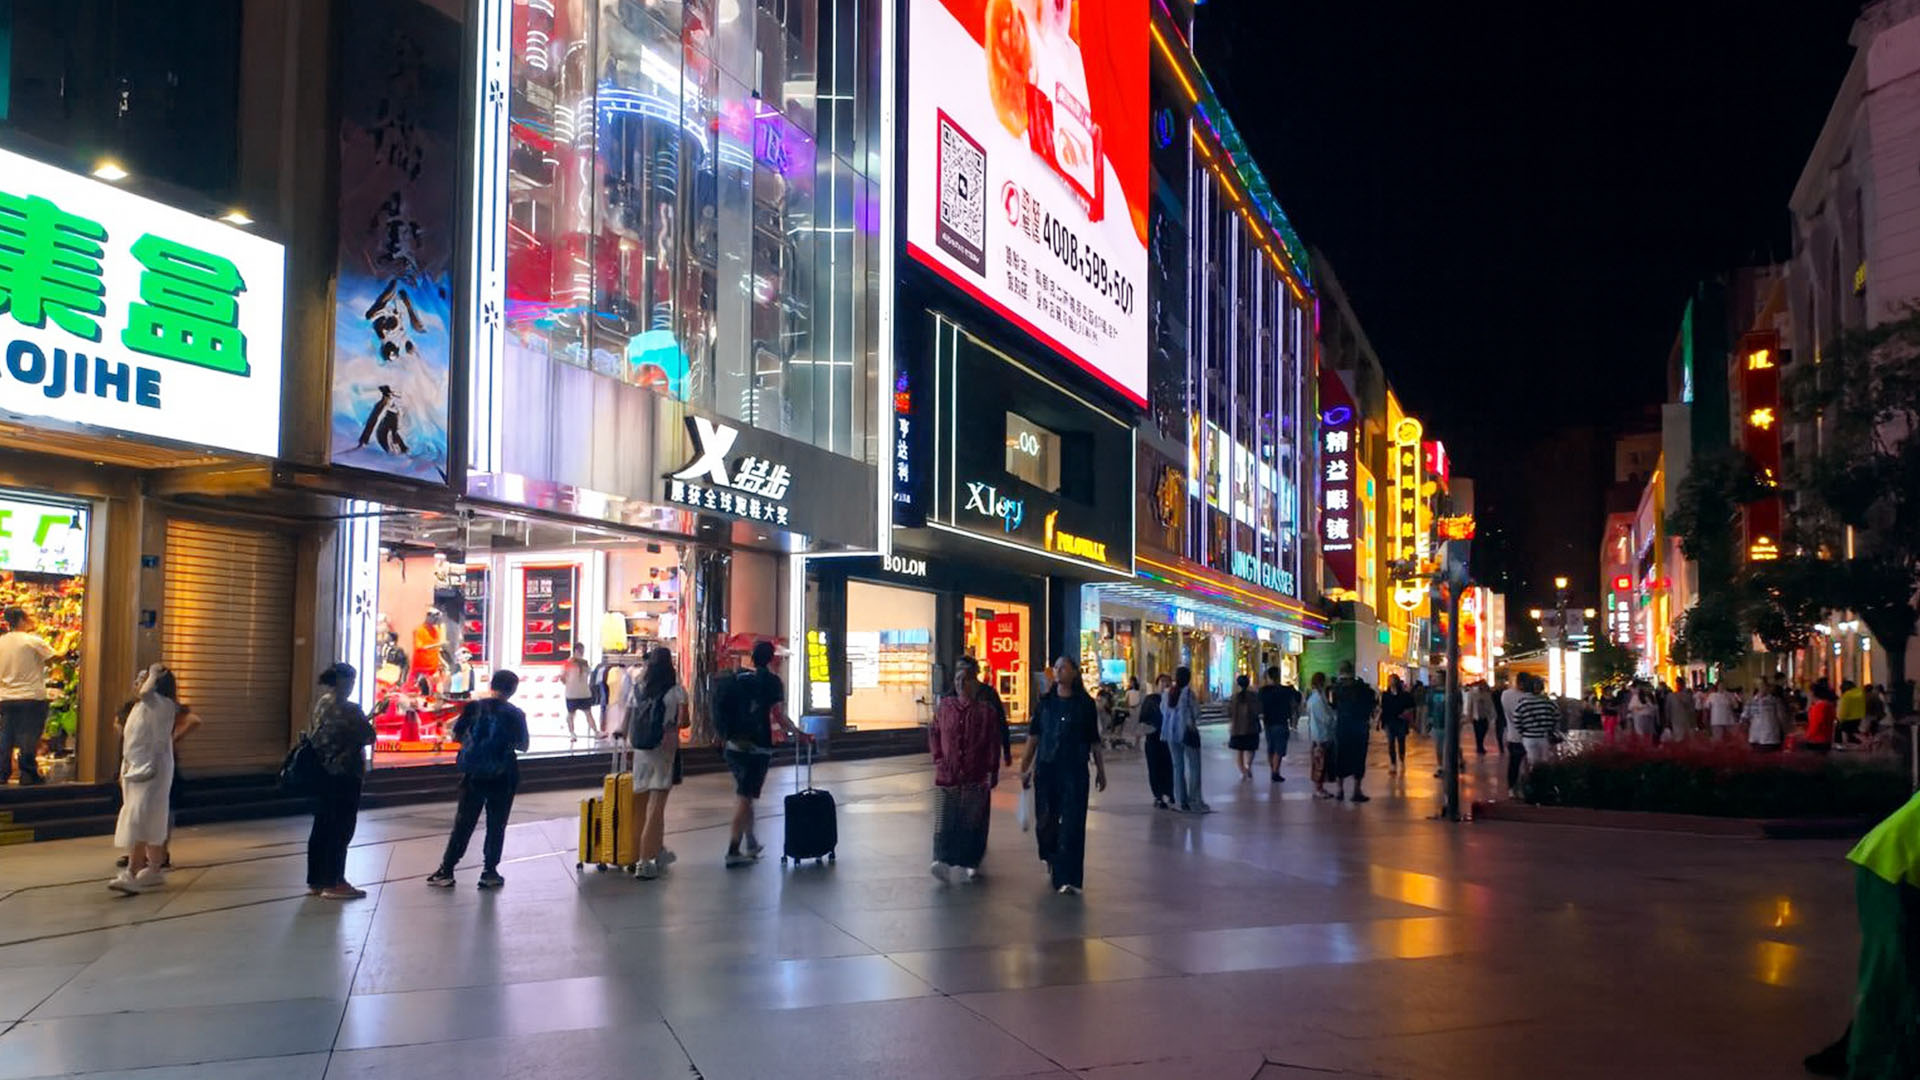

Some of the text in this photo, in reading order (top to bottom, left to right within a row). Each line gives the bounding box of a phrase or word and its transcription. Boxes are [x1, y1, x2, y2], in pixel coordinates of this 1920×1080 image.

[0, 338, 162, 409] OJIHE
[729, 456, 792, 500] 特步
[883, 554, 927, 577] BOLON
